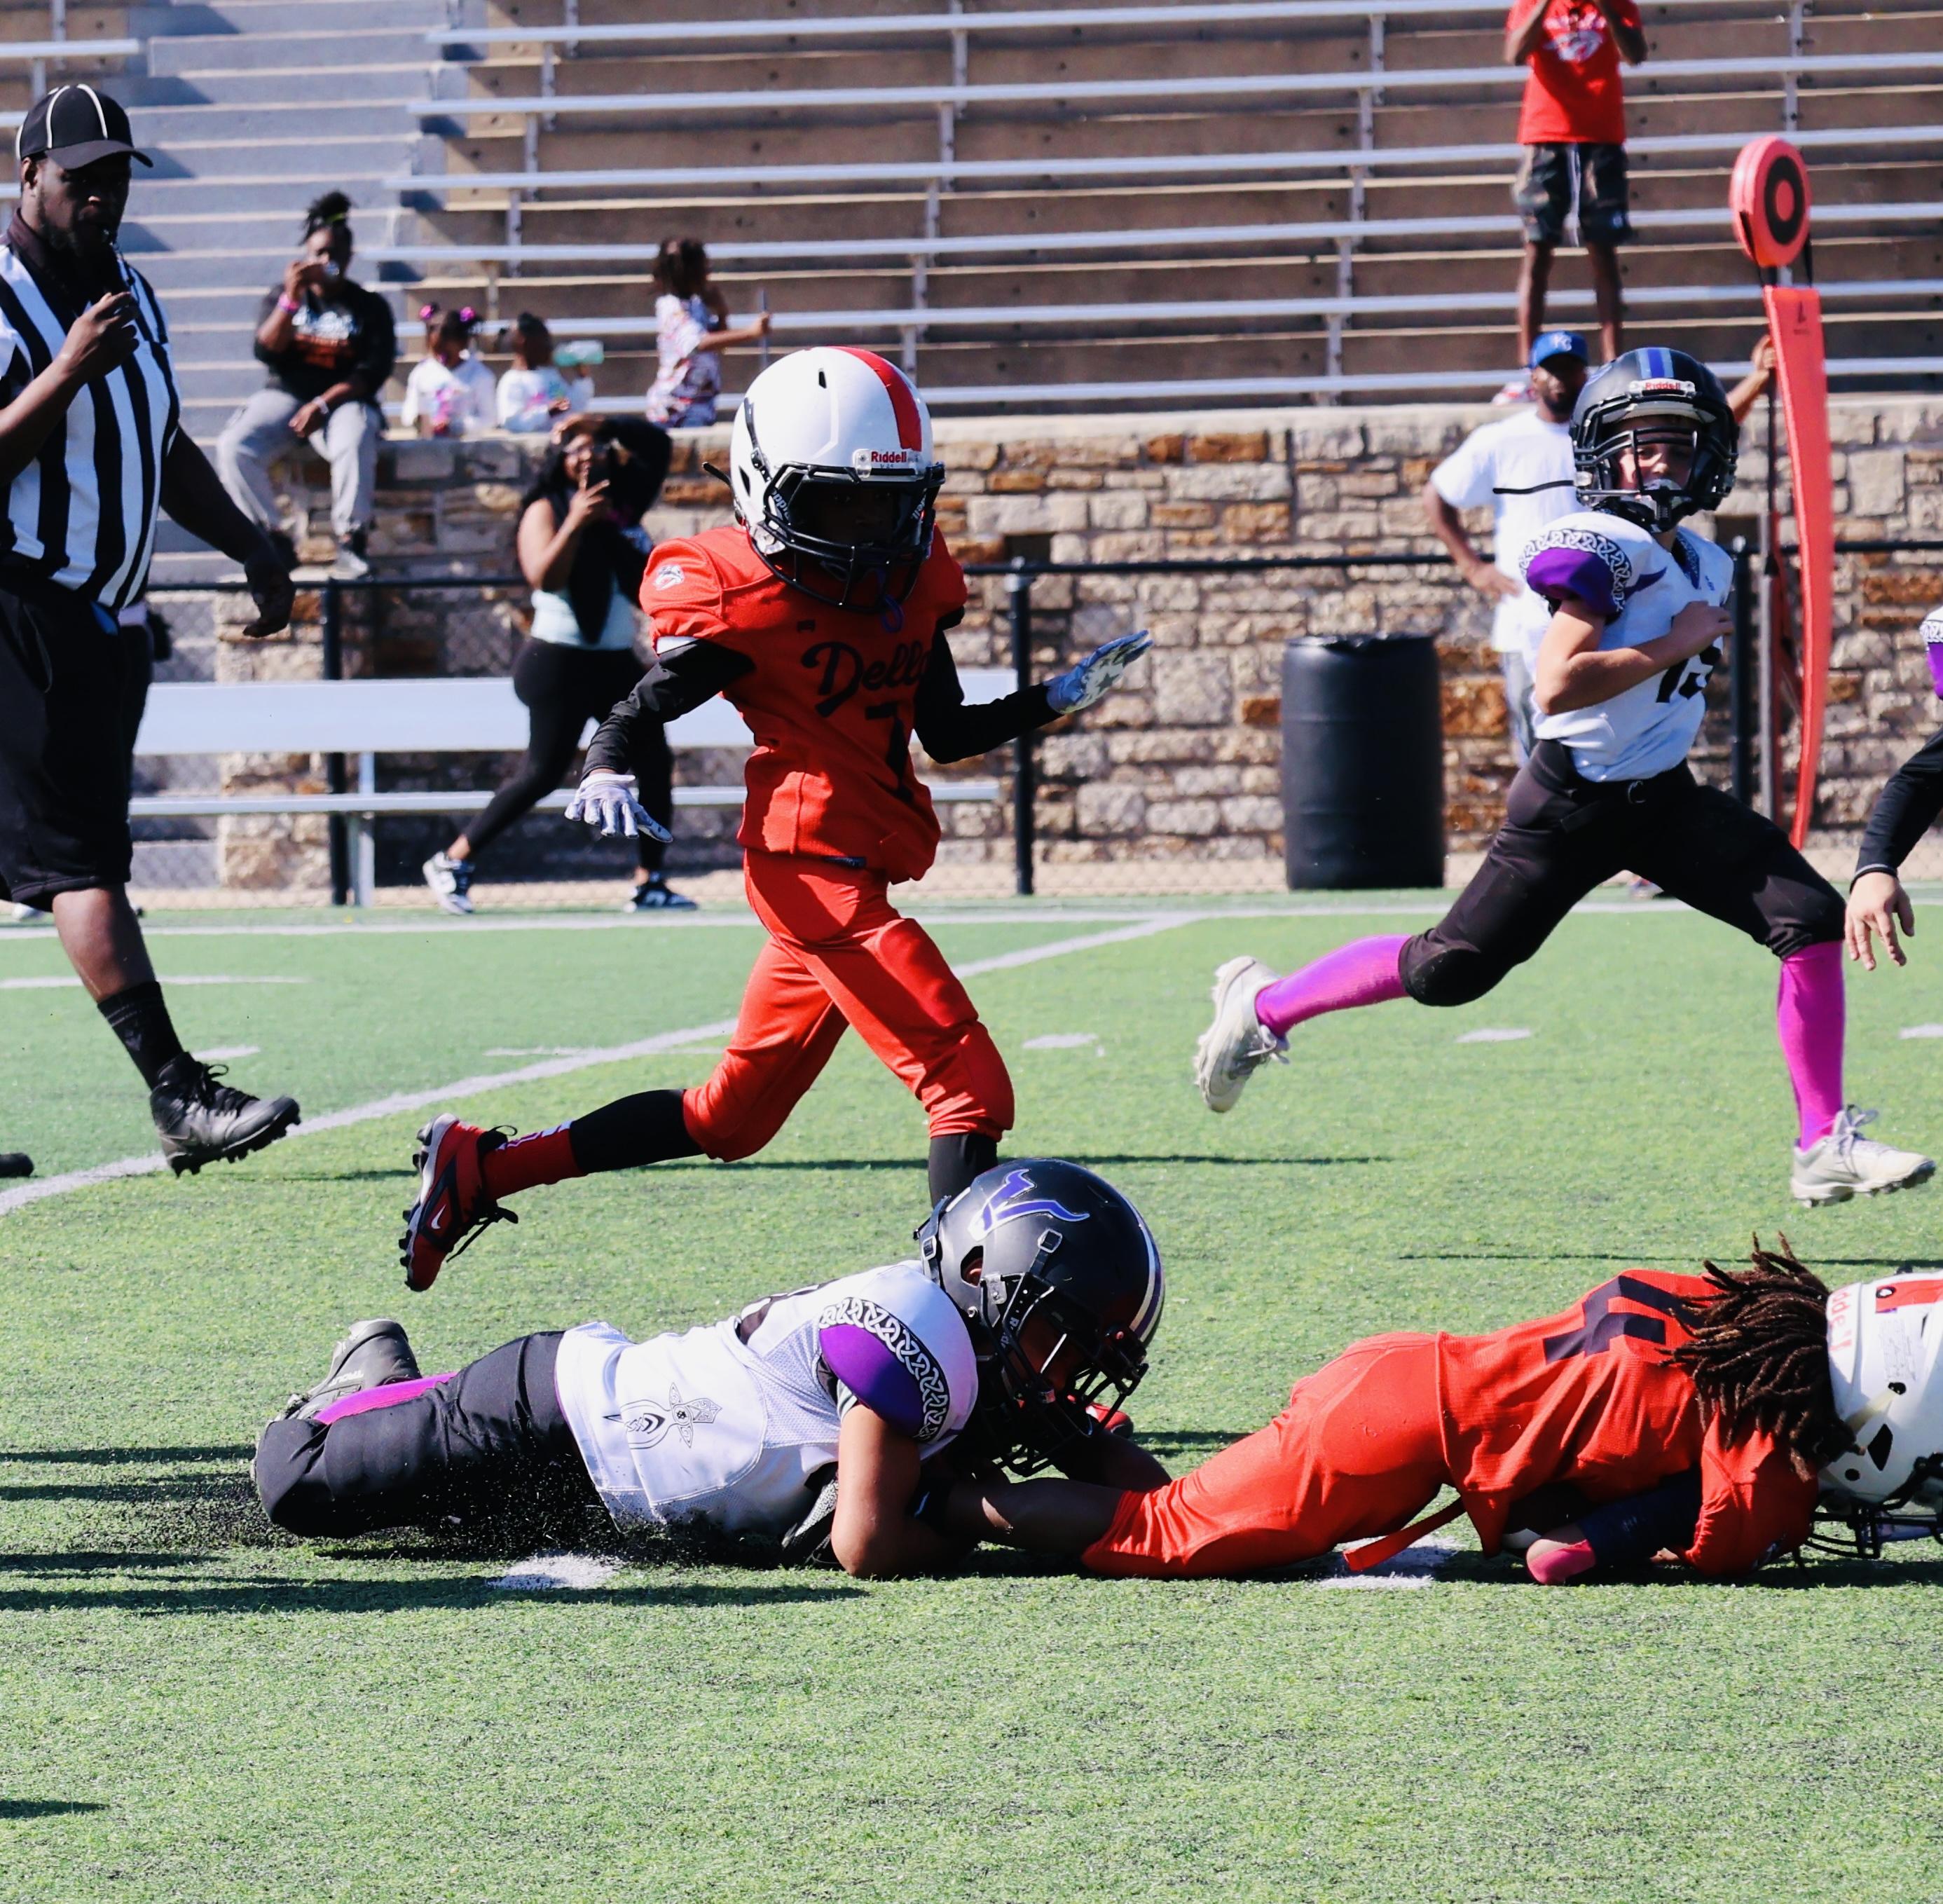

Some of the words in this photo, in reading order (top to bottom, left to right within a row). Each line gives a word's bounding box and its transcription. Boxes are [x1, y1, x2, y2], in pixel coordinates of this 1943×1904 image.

[1645, 382, 1680, 390] Riddell
[871, 451, 907, 463] Riddell
[865, 702, 915, 802] 7
